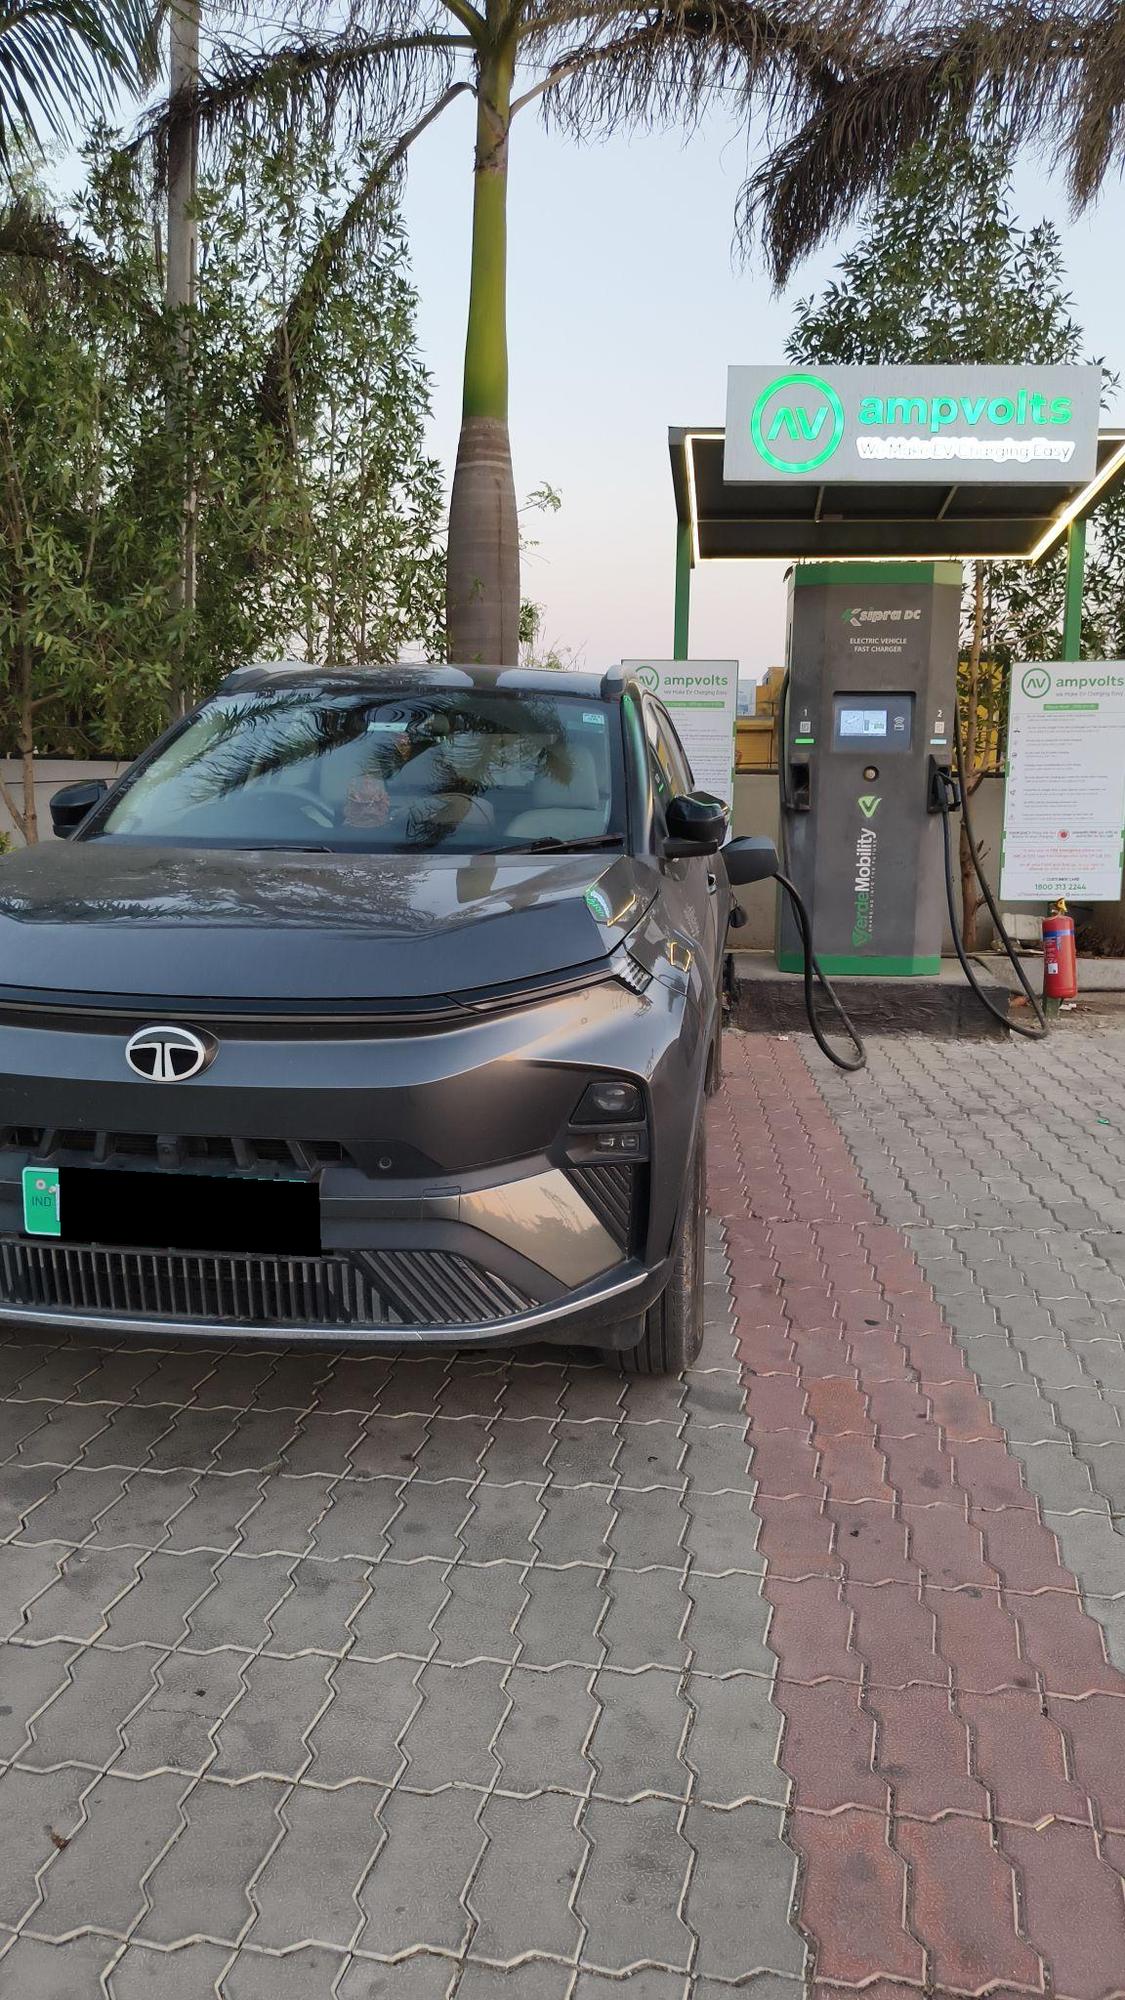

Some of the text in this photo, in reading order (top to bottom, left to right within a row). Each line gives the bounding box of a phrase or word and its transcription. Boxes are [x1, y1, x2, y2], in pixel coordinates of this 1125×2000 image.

[858, 389, 1073, 433] ampvolts
[860, 441, 1072, 462] We Make EV Charging Easy
[904, 610, 922, 620] DC
[664, 675, 729, 688] ampvolts
[1056, 675, 1125, 690] ampvolts
[938, 709, 943, 717] 2
[31, 1196, 52, 1207] IND
